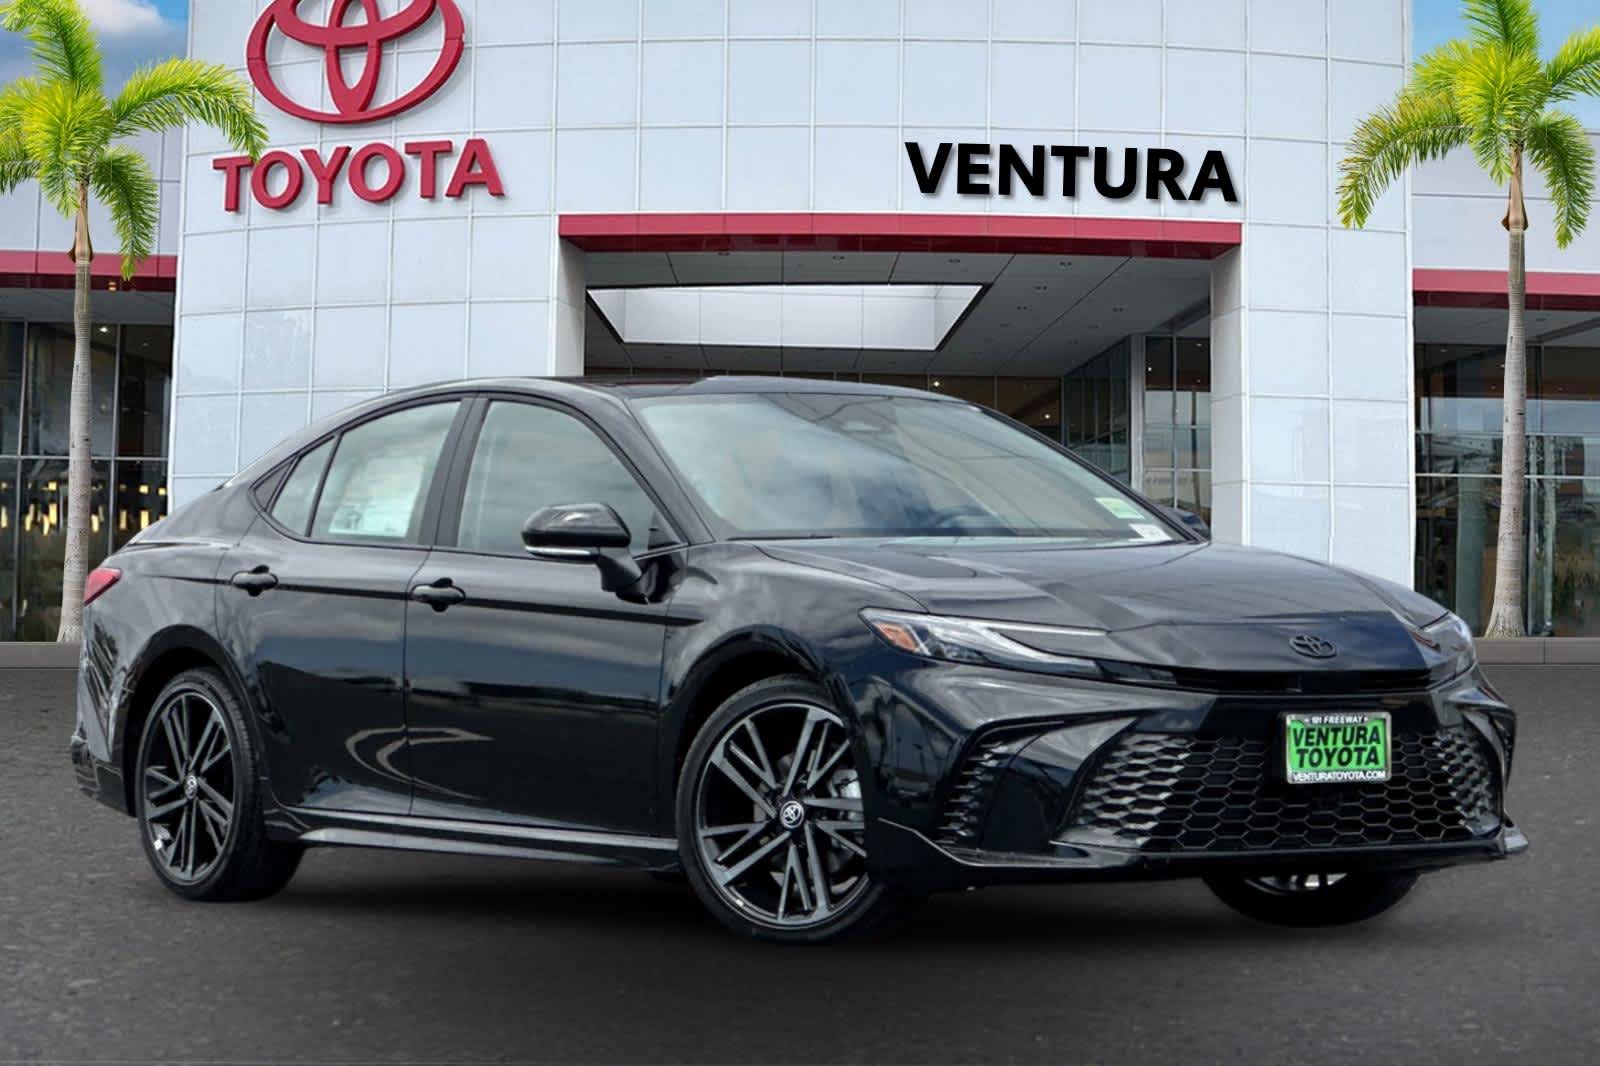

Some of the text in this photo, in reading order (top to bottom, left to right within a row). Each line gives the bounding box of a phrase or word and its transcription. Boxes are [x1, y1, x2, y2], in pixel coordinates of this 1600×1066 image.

[213, 138, 505, 213] TOYOTA
[904, 141, 1239, 203] VENTURA
[1324, 715, 1363, 724] FREEWAY
[1293, 725, 1381, 747] VENTURA
[1296, 746, 1380, 768] TOYOTA
[1293, 770, 1386, 781] VENTURATOYOTA.COM
